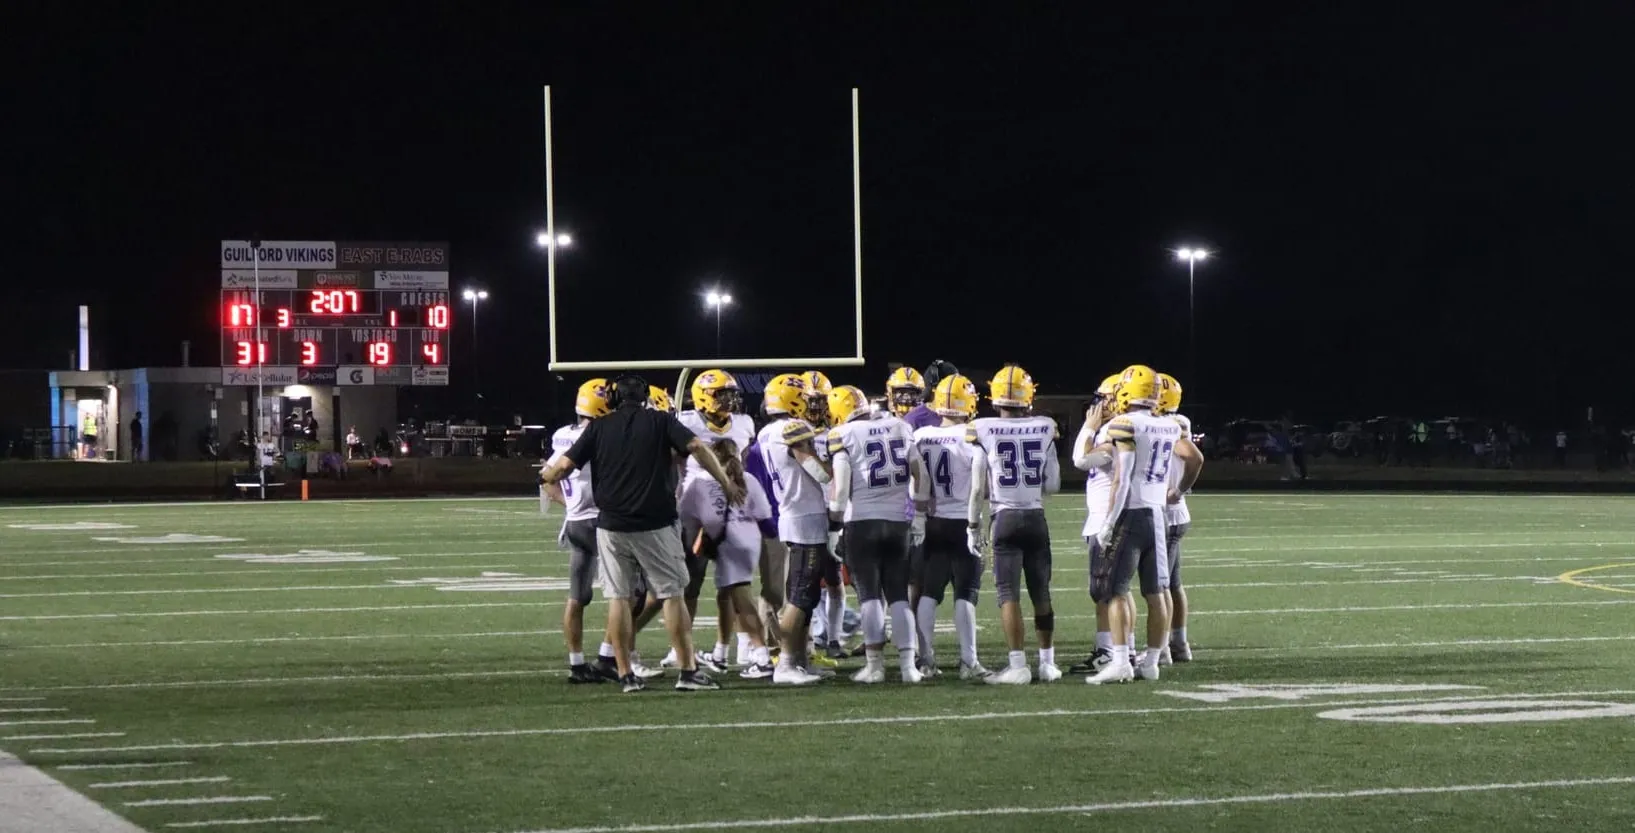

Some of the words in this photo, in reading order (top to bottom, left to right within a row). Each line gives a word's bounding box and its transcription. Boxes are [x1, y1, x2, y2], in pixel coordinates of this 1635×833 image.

[287, 247, 334, 262] VIKINGS
[341, 247, 383, 264] EAST
[311, 290, 357, 313] 2:07
[401, 292, 446, 306] GUESTS
[231, 304, 252, 326] 17
[278, 308, 289, 328] 3
[390, 310, 396, 327] 1
[428, 305, 448, 328] 10
[293, 329, 322, 343] DOWN
[238, 341, 265, 365] 31
[302, 341, 315, 365] 3
[369, 342, 389, 365] 19
[424, 343, 438, 364] 4
[350, 369, 364, 384] G
[987, 426, 1049, 436] MUELLER
[865, 438, 910, 489] 25
[996, 438, 1045, 489] 35
[1146, 439, 1173, 484] 13
[922, 448, 954, 498] 14
